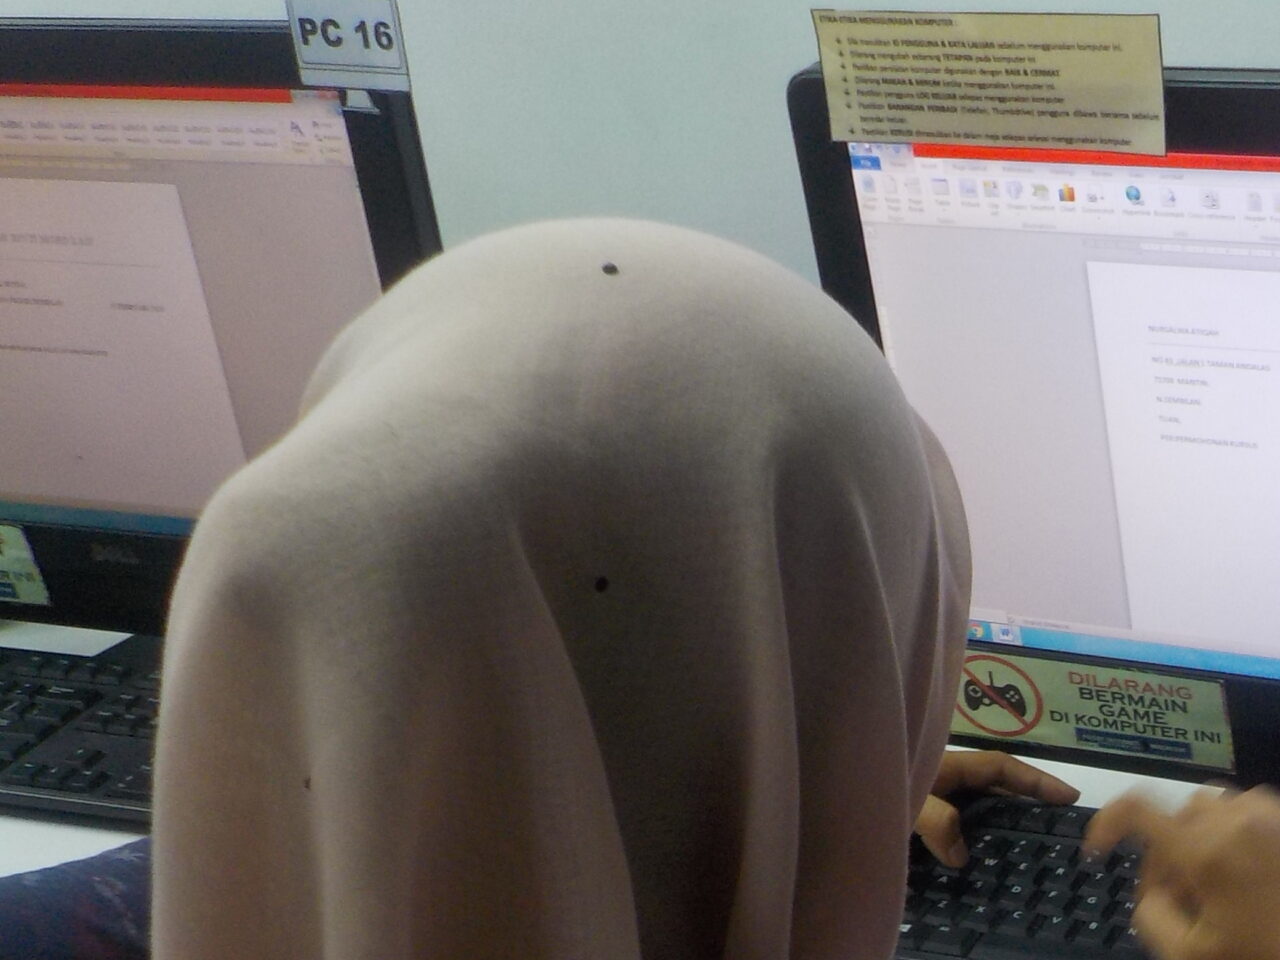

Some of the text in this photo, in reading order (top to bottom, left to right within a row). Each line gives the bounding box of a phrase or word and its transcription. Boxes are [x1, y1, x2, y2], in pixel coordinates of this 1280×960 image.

[298, 17, 394, 50] PC 16
[1067, 670, 1193, 700] DILARANG
[1078, 686, 1189, 714] BERMAIN
[1049, 709, 1070, 724] DI
[1074, 713, 1188, 741] KOMPUTER
[1194, 729, 1222, 744] INI
[1098, 703, 1168, 726] GAME
